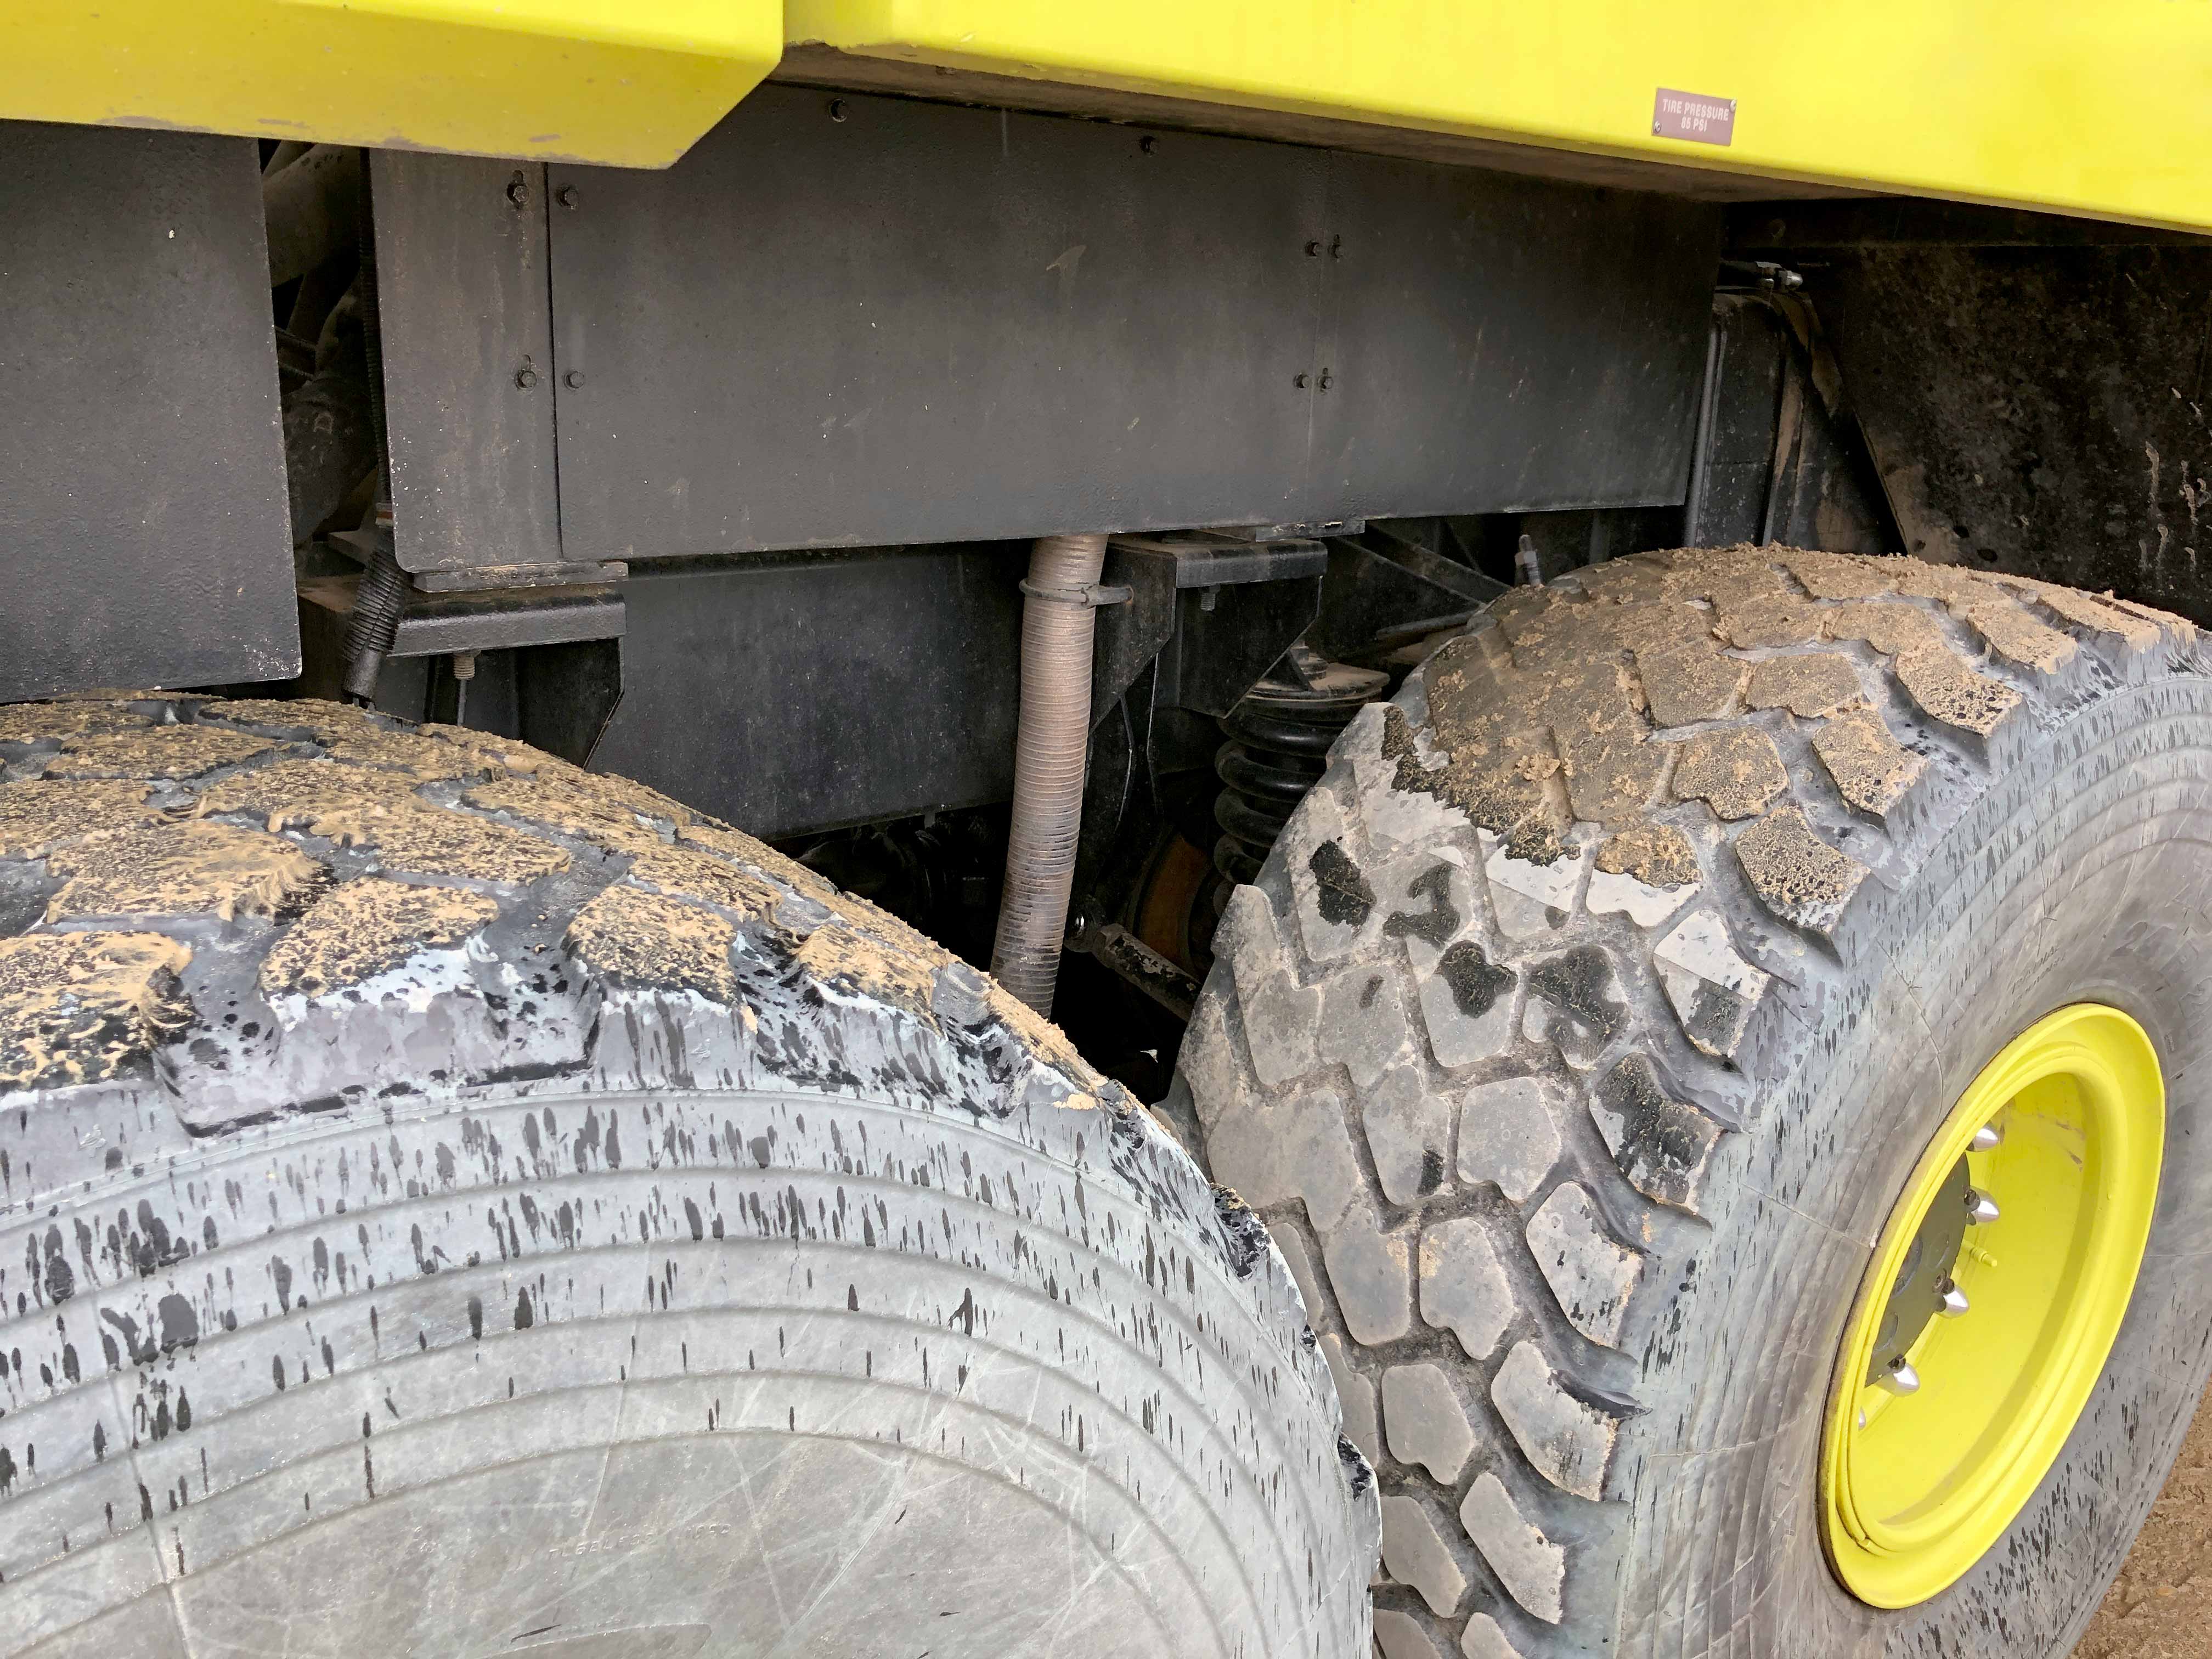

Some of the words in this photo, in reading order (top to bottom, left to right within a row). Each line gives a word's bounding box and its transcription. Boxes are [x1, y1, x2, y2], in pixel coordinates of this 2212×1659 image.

[1663, 98, 1682, 114] TIRE
[1684, 102, 1729, 121] PRESSURE
[1681, 116, 1691, 129] 85
[1693, 118, 1707, 132] PSI
